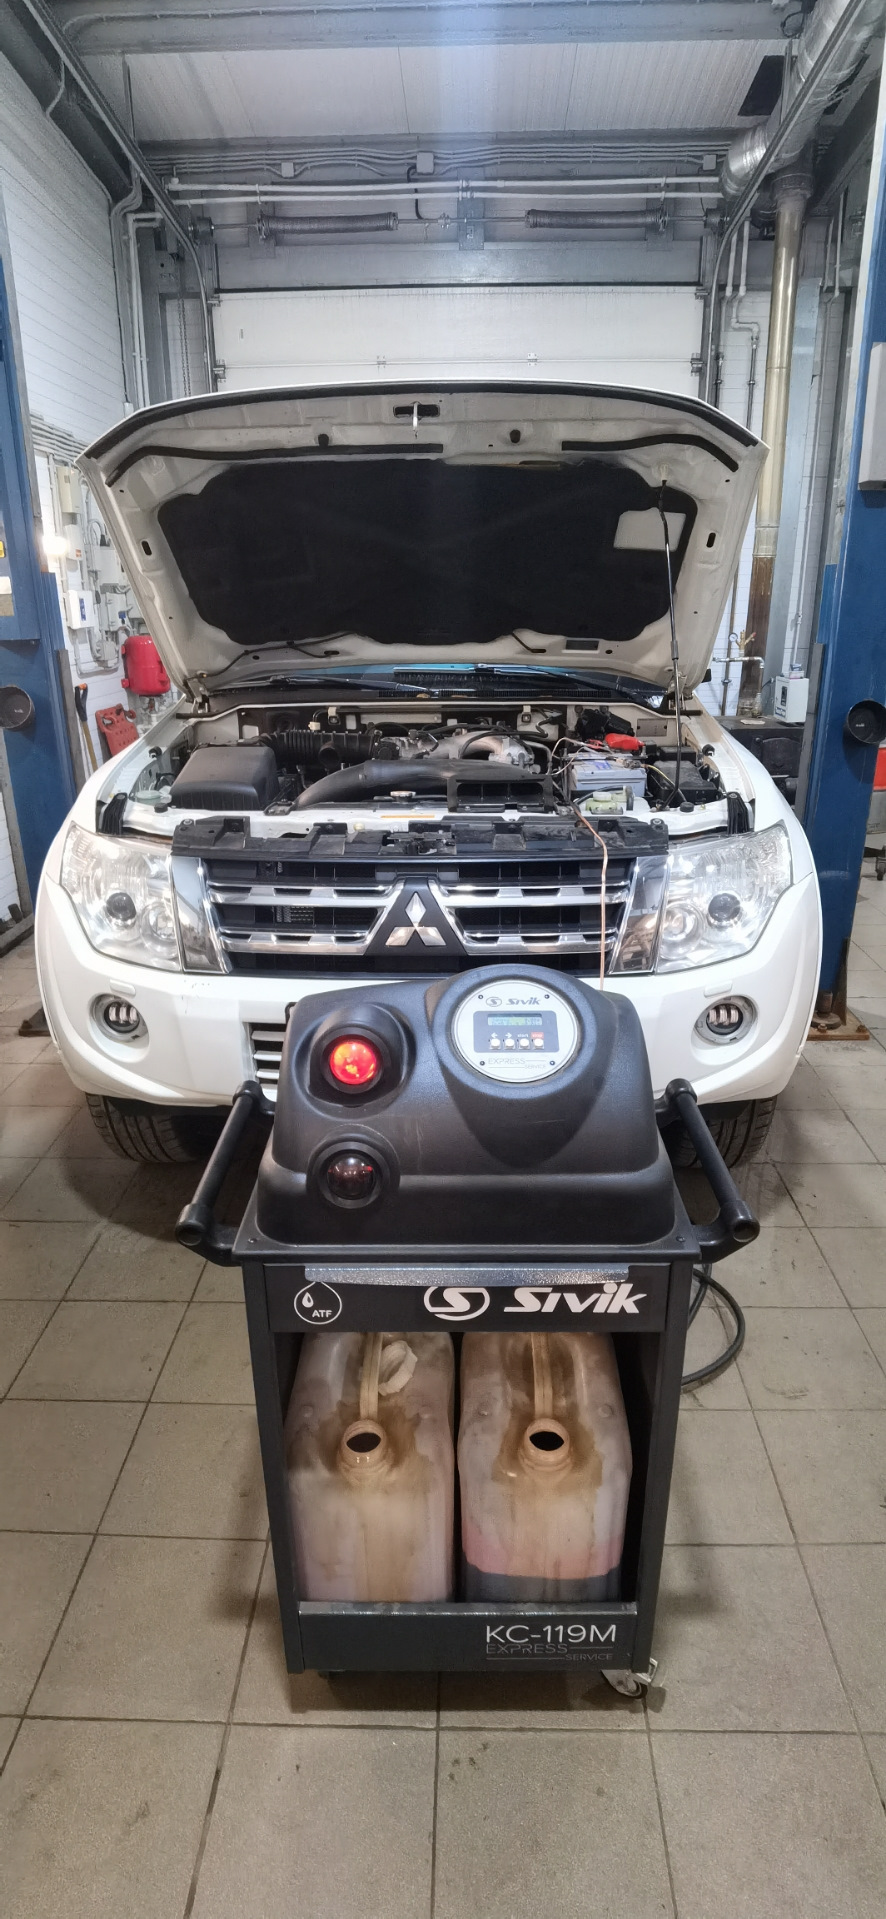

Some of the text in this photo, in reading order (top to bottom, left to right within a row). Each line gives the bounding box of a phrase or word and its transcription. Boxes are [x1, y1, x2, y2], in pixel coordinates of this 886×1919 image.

[311, 1309, 333, 1318] ATF
[486, 1624, 617, 1643] KC-119M
[486, 1643, 568, 1654] EXPRESS
[565, 1653, 613, 1661] SERVICE
